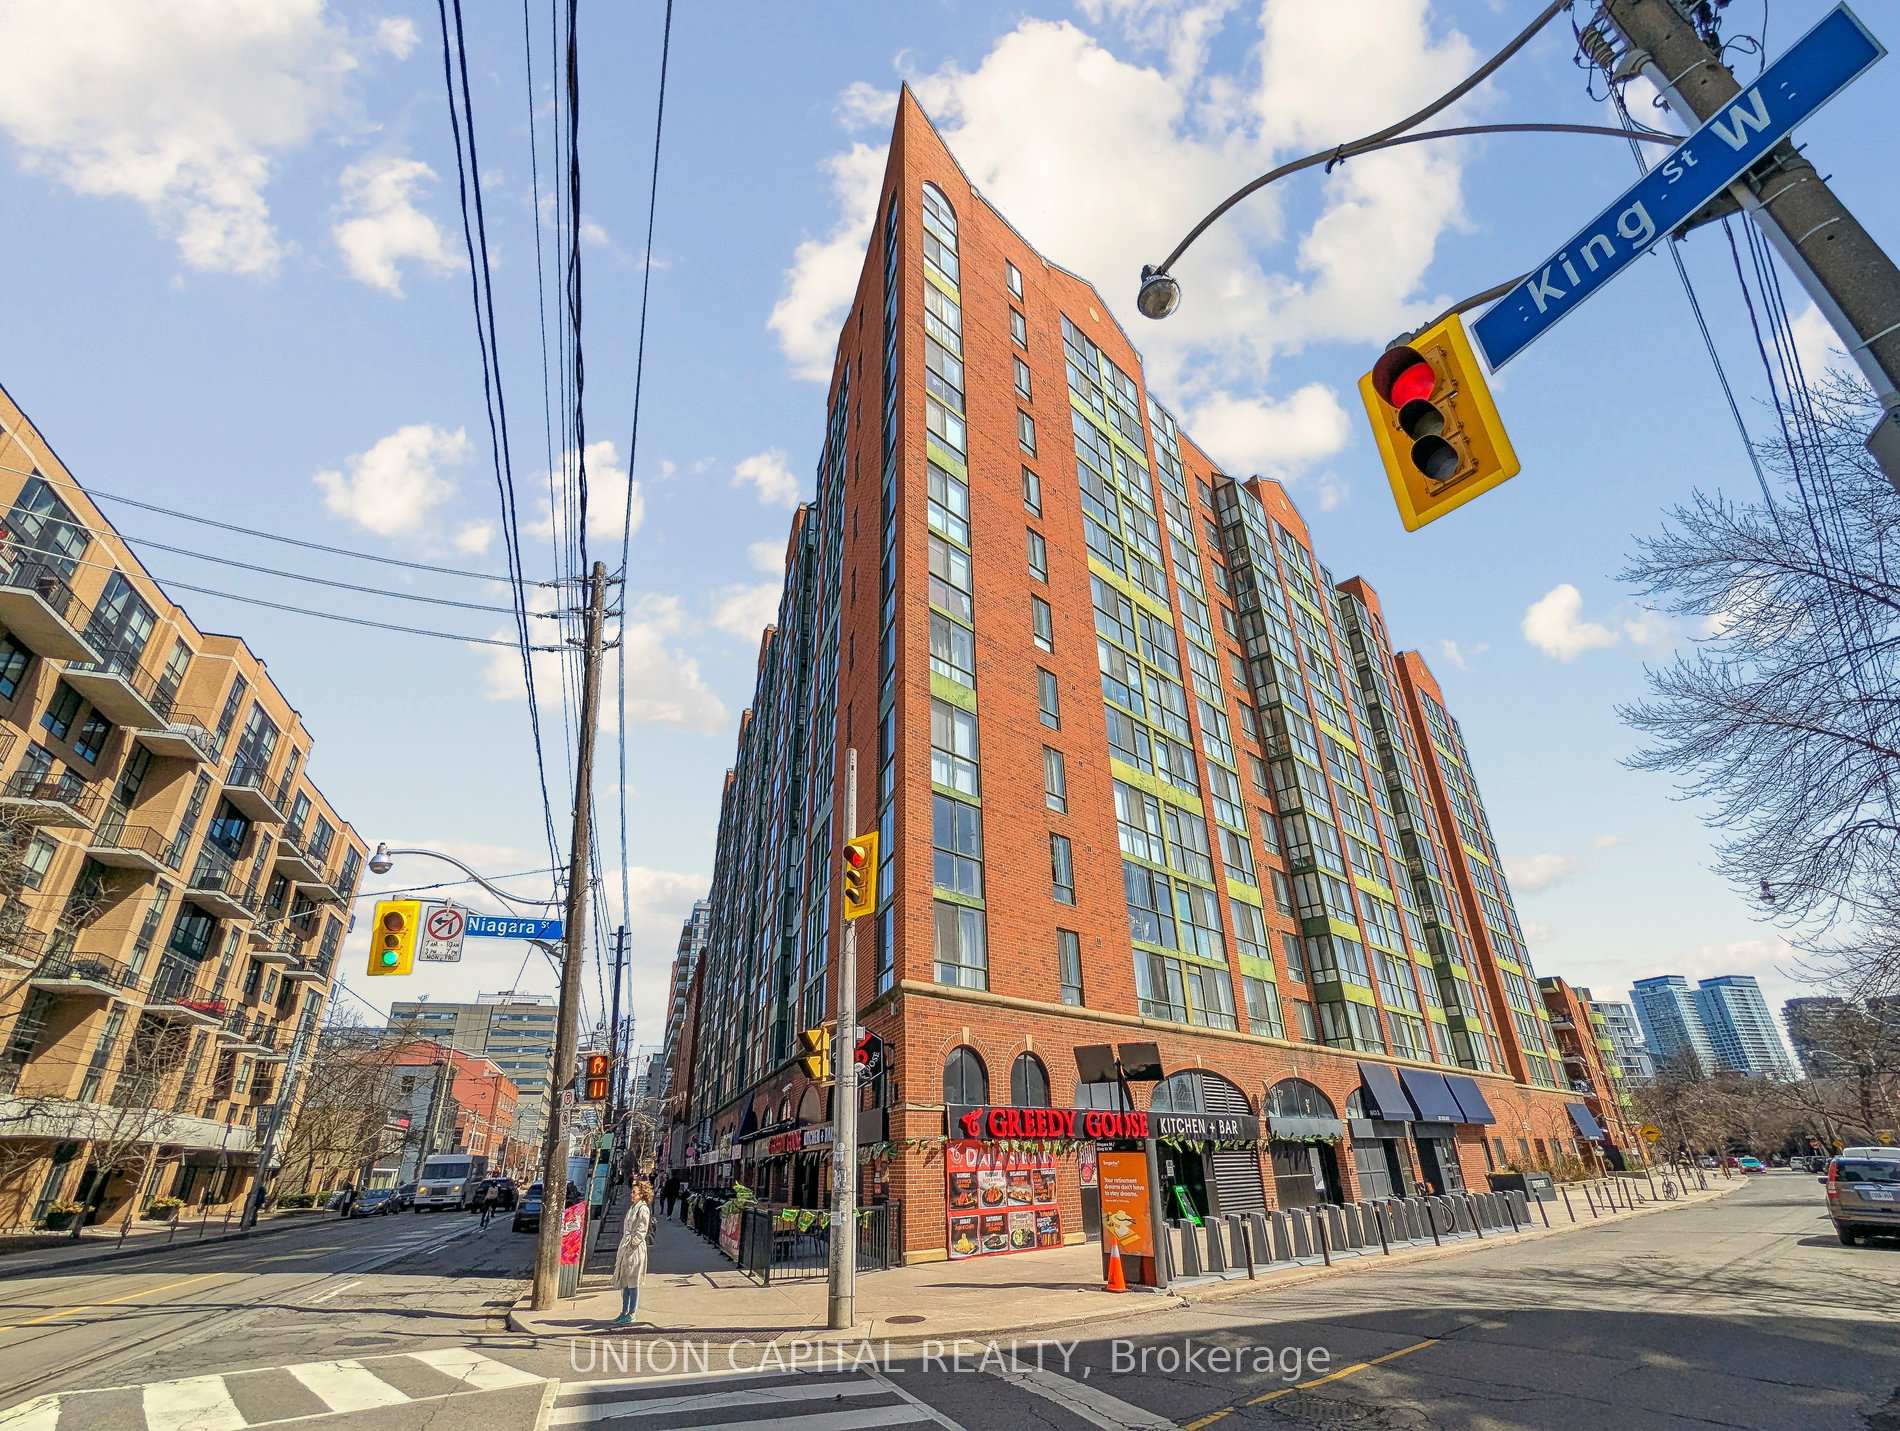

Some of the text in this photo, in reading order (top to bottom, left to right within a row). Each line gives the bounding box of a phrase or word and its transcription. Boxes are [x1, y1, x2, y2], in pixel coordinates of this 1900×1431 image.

[1527, 87, 1771, 314] King St W
[468, 917, 550, 936] Niagara St
[988, 1108, 1238, 1138] GREEDY GOOSE KITCHEN + BAR
